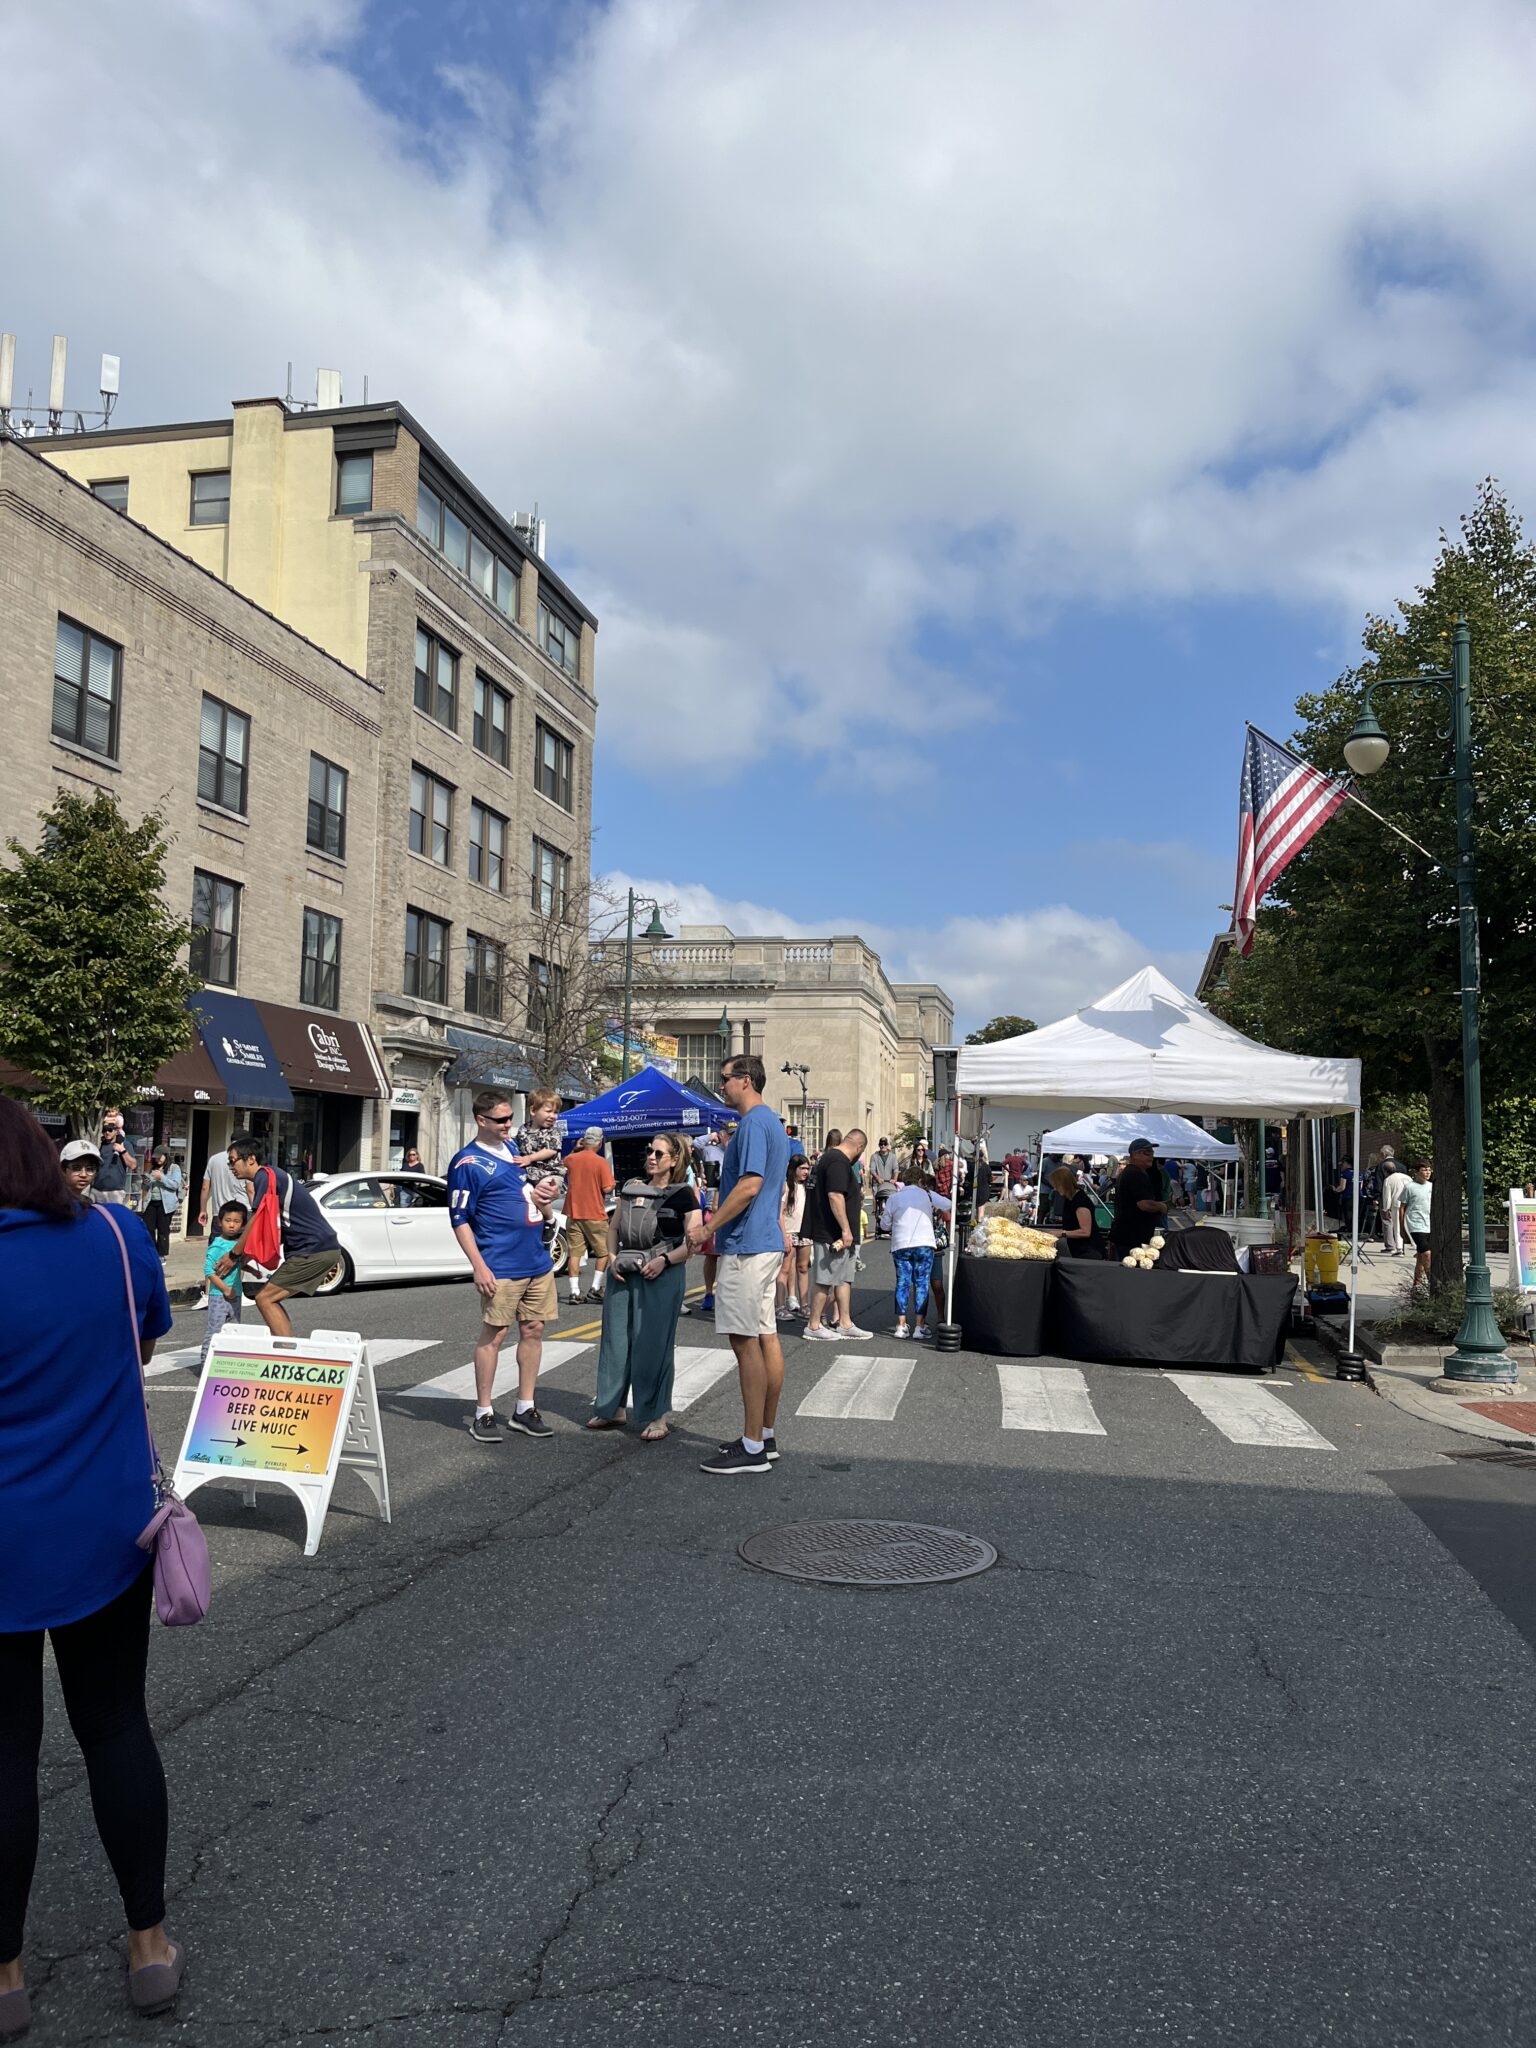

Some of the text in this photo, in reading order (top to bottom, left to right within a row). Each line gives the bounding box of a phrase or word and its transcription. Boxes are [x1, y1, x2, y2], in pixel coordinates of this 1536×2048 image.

[233, 1039, 260, 1052] SUMMIT
[308, 1023, 341, 1053] Cabri
[239, 1048, 265, 1061] SMILES
[601, 1114, 648, 1123] 908-522-0077
[260, 1364, 345, 1385] ARTS&CARS
[213, 1385, 333, 1406] FOOD TRUCK ALLEY
[227, 1402, 310, 1420] BEER GARDEN
[231, 1419, 298, 1437] LIVE MUSIC
